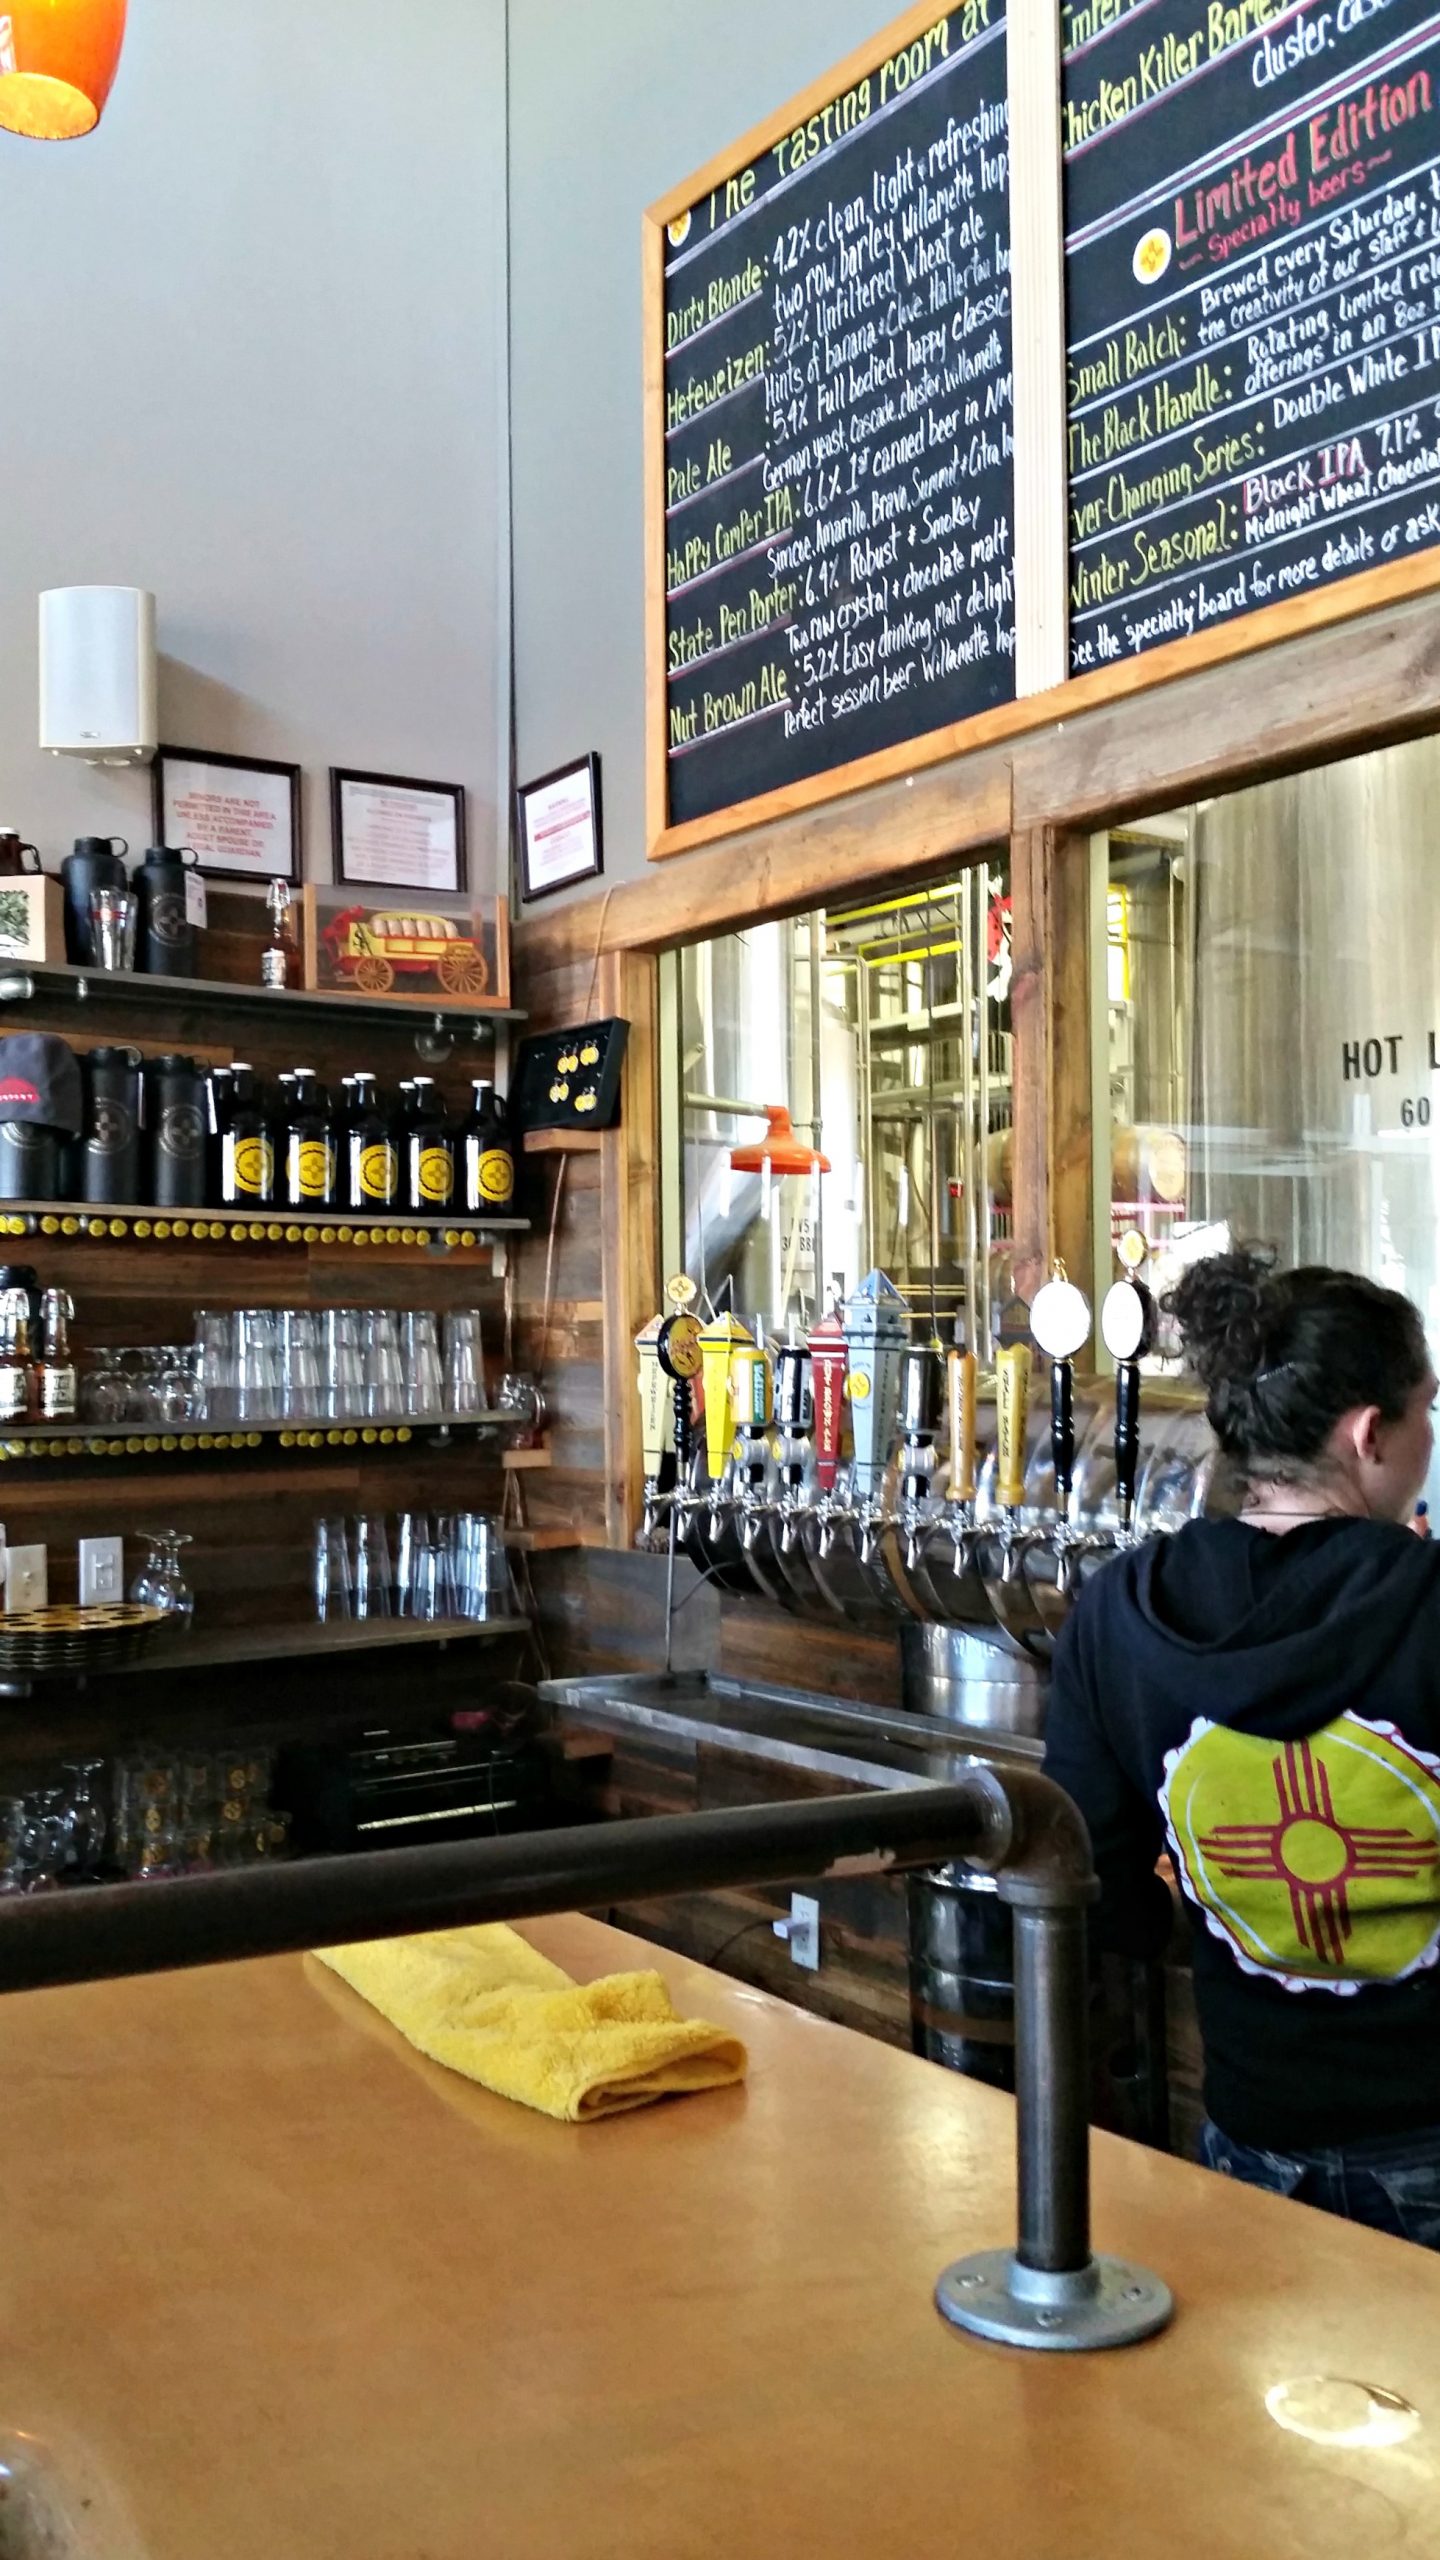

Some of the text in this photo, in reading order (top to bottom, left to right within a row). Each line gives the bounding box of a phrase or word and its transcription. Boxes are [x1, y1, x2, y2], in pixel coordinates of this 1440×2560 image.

[1063, 76, 1138, 149] hicken
[1139, 31, 1204, 100] Killer
[1252, 14, 1335, 88] cluster.
[773, 77, 871, 177] Tasting
[881, 18, 950, 104] room
[1175, 70, 1432, 249] Limited Edition
[1308, 160, 1366, 208] beers
[773, 218, 811, 276] 4.2%
[874, 147, 914, 214] light
[1200, 256, 1268, 317] Brewed
[1275, 235, 1326, 278] every
[1329, 191, 1427, 249] Saturday.
[668, 257, 769, 349] Dirty Blonde:
[772, 283, 803, 323] two
[805, 256, 836, 304] row
[773, 206, 987, 364] 5.2% Unfiltered Wheat ale
[1197, 318, 1227, 346] the
[1231, 274, 1304, 330] creativity
[1309, 259, 1329, 295] of
[1333, 247, 1362, 282] our
[1369, 217, 1411, 263] staff
[1339, 266, 1405, 322] limited
[764, 359, 804, 412] Hints
[807, 340, 820, 384] of
[825, 321, 878, 375] banana
[773, 392, 809, 446] 5.4%
[817, 372, 846, 422] Full
[906, 323, 947, 371] happy
[952, 286, 1011, 342] classic
[1245, 344, 1326, 396] offerings
[1332, 322, 1353, 356] in
[1361, 312, 1387, 343] an
[1273, 376, 1347, 430] Double
[1347, 347, 1410, 397] White
[969, 429, 1002, 477] Citra
[1103, 394, 1153, 460] Black
[1155, 362, 1233, 434] Handle:
[668, 458, 701, 507] Pale
[762, 445, 812, 492] German
[803, 464, 842, 519] 6.6%
[872, 415, 925, 477] canned
[928, 407, 960, 447] beer
[964, 396, 979, 426] in
[1242, 413, 1421, 516] Black IPA 7.1%
[667, 536, 711, 590] Happy
[715, 508, 762, 562] Camper
[804, 553, 840, 607] 6.4%
[850, 521, 902, 584] Robust
[921, 495, 981, 545] Smokey
[1130, 498, 1239, 586] Seasonal:
[1244, 492, 1318, 545] Midnight
[784, 623, 809, 656] Two
[810, 609, 834, 642] row
[837, 575, 889, 629] crystal
[903, 541, 965, 598] chocolate
[971, 516, 1009, 567] malt
[803, 640, 840, 688] 5.2%
[843, 631, 875, 676] Easy
[934, 590, 963, 633] Malt
[966, 556, 1015, 623] delight
[1096, 623, 1122, 660] the
[1198, 571, 1248, 622] board
[1250, 560, 1276, 598] for
[1279, 556, 1320, 590] more
[1322, 526, 1376, 573] details
[1381, 524, 1401, 553] or
[1405, 502, 1440, 543] ask
[669, 617, 715, 671] State
[719, 604, 747, 648] Pen
[784, 688, 827, 739] Perfect
[832, 675, 881, 720] session
[921, 622, 991, 683] Willamette
[670, 699, 698, 747] Nut
[703, 680, 756, 732] Brown
[1343, 1036, 1403, 1080] HOT
[1400, 1096, 1430, 1128] 60
